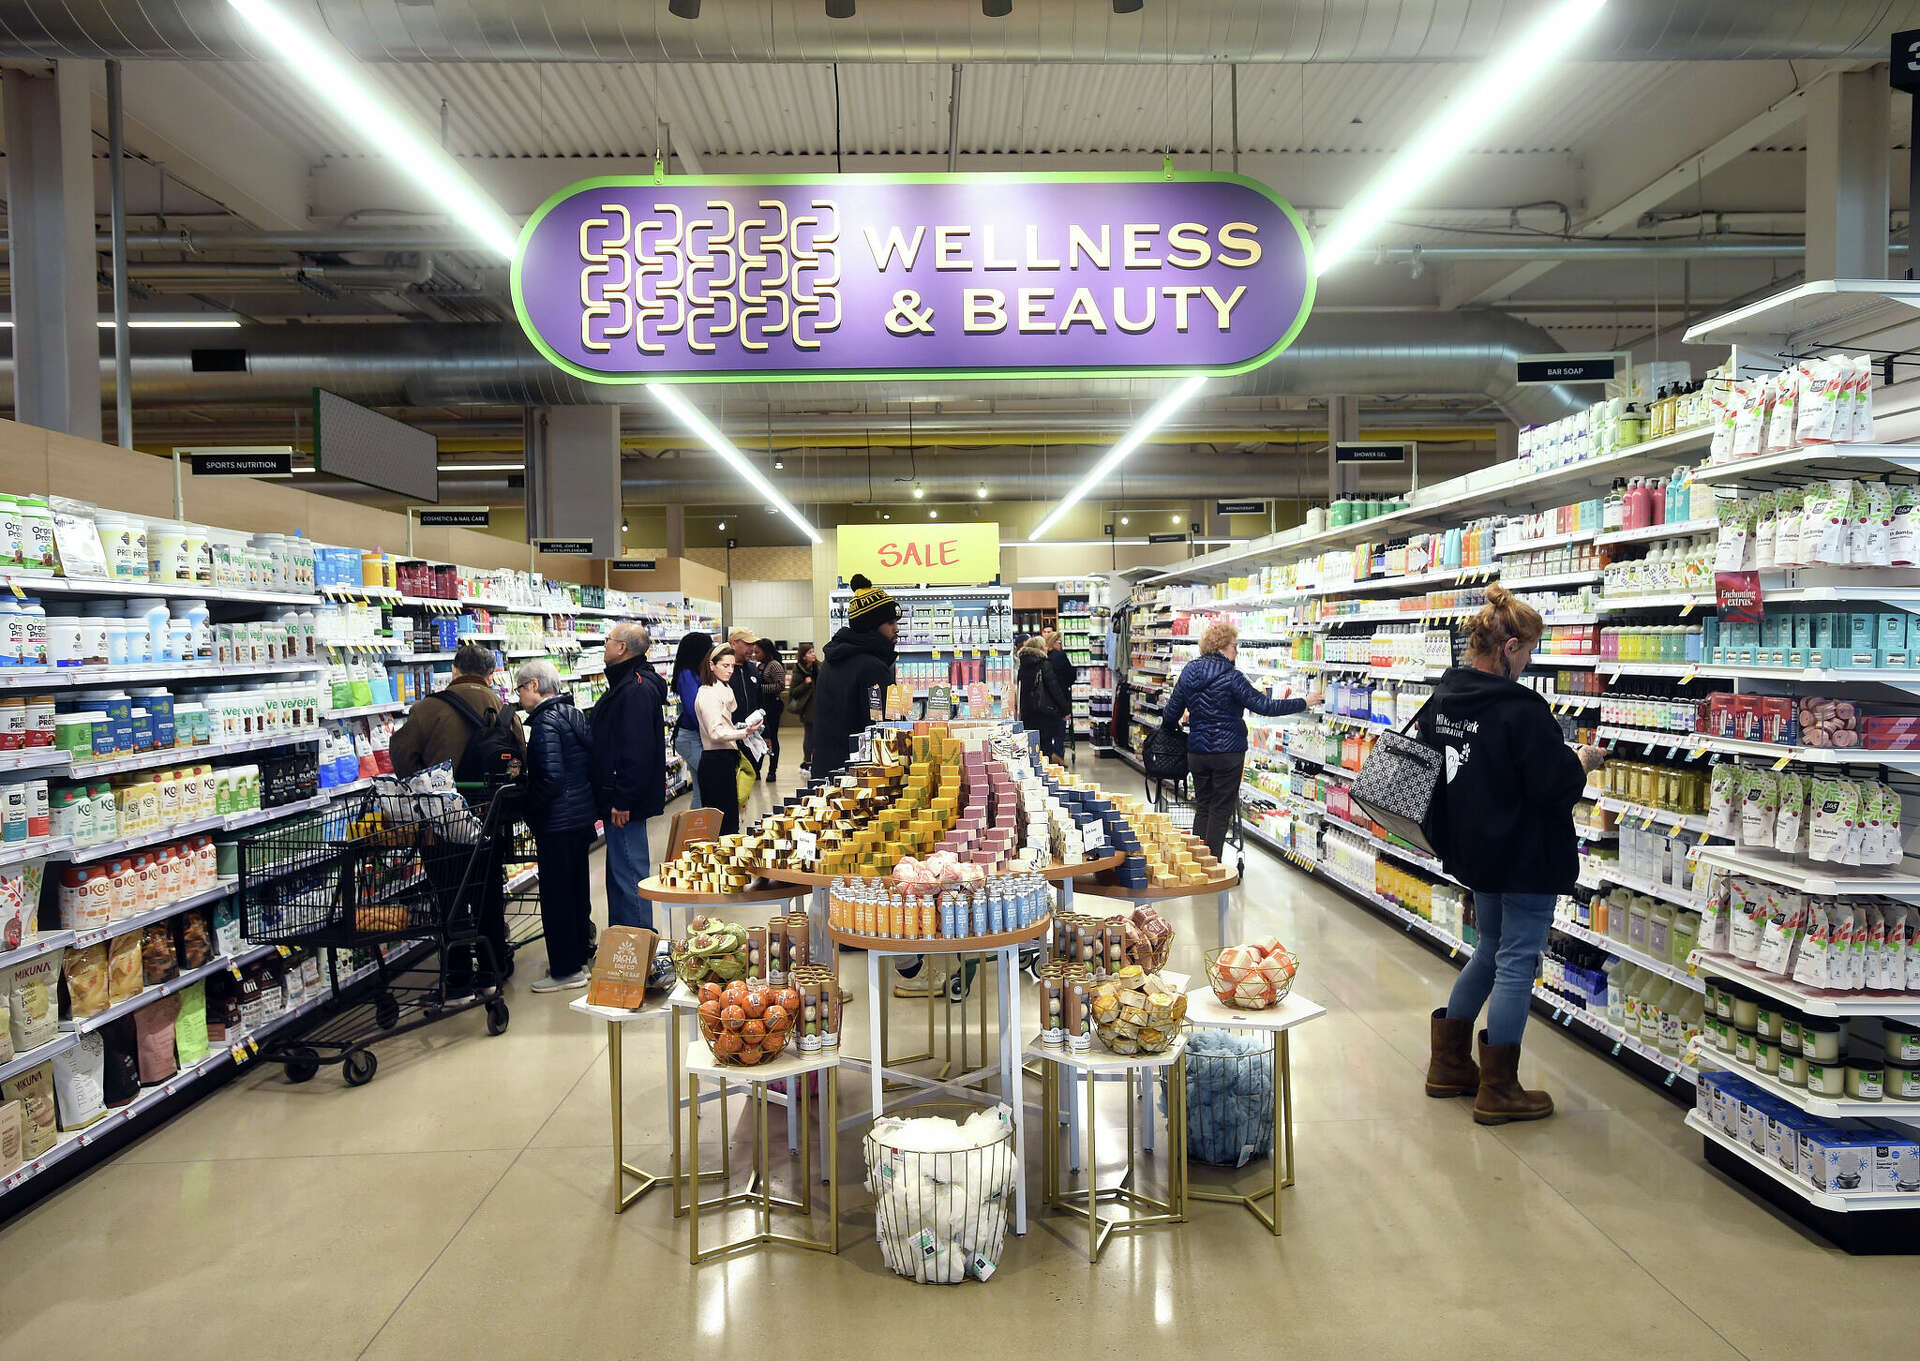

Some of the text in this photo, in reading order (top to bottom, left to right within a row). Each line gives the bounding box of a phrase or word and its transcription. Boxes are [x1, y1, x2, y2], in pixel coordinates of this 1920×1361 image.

[863, 221, 1263, 272] WELLNESS
[884, 285, 1248, 336] & BEAUTY
[1547, 367, 1584, 376] BAR SOAP
[206, 461, 277, 469] SPORTS NUTRITION
[877, 539, 960, 567] SALE
[1721, 589, 1756, 600] Enchanting
[1727, 598, 1753, 607] extras.
[1463, 719, 1480, 733] Park
[1824, 801, 1838, 810] 365
[612, 953, 638, 965] PACHA
[15, 962, 51, 981] MIKUNA
[26, 1016, 32, 1025] 5
[32, 1124, 39, 1133] 7
